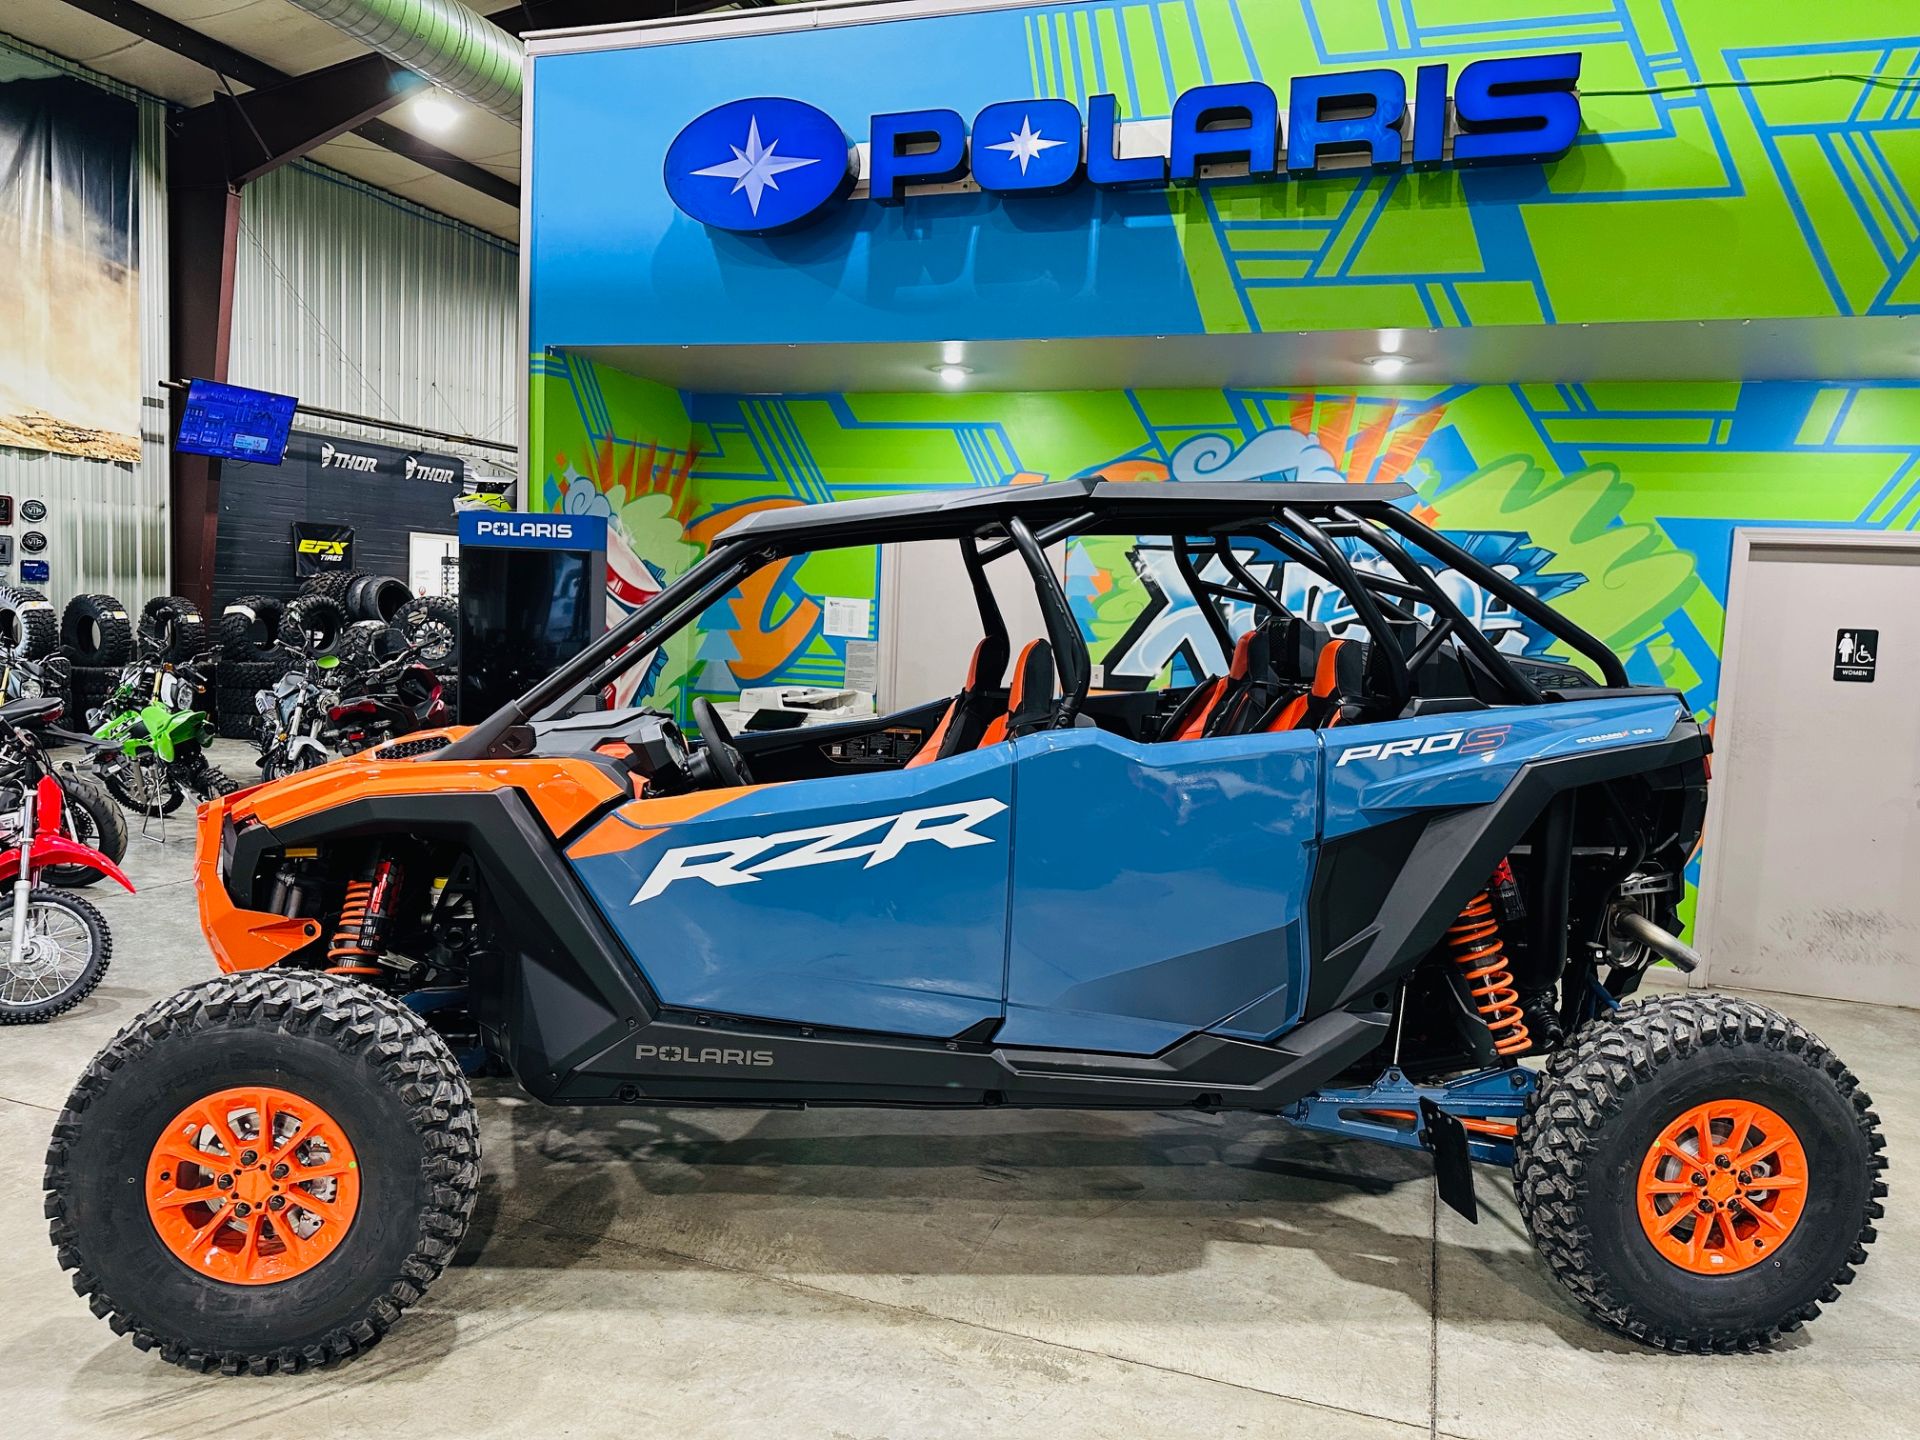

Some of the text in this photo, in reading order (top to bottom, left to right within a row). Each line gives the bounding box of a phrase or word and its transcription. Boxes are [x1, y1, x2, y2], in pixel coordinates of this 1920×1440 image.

[868, 51, 1583, 201] POLARIS
[333, 451, 379, 473] THOR
[416, 465, 455, 484] THOR
[477, 521, 573, 539] POLARIS
[297, 538, 350, 555] EFX
[320, 554, 344, 562] TIRES
[1842, 669, 1868, 677] WOMEN
[1335, 731, 1465, 768] PRO
[629, 797, 1009, 906] RZR
[635, 1044, 774, 1067] POLARIS
